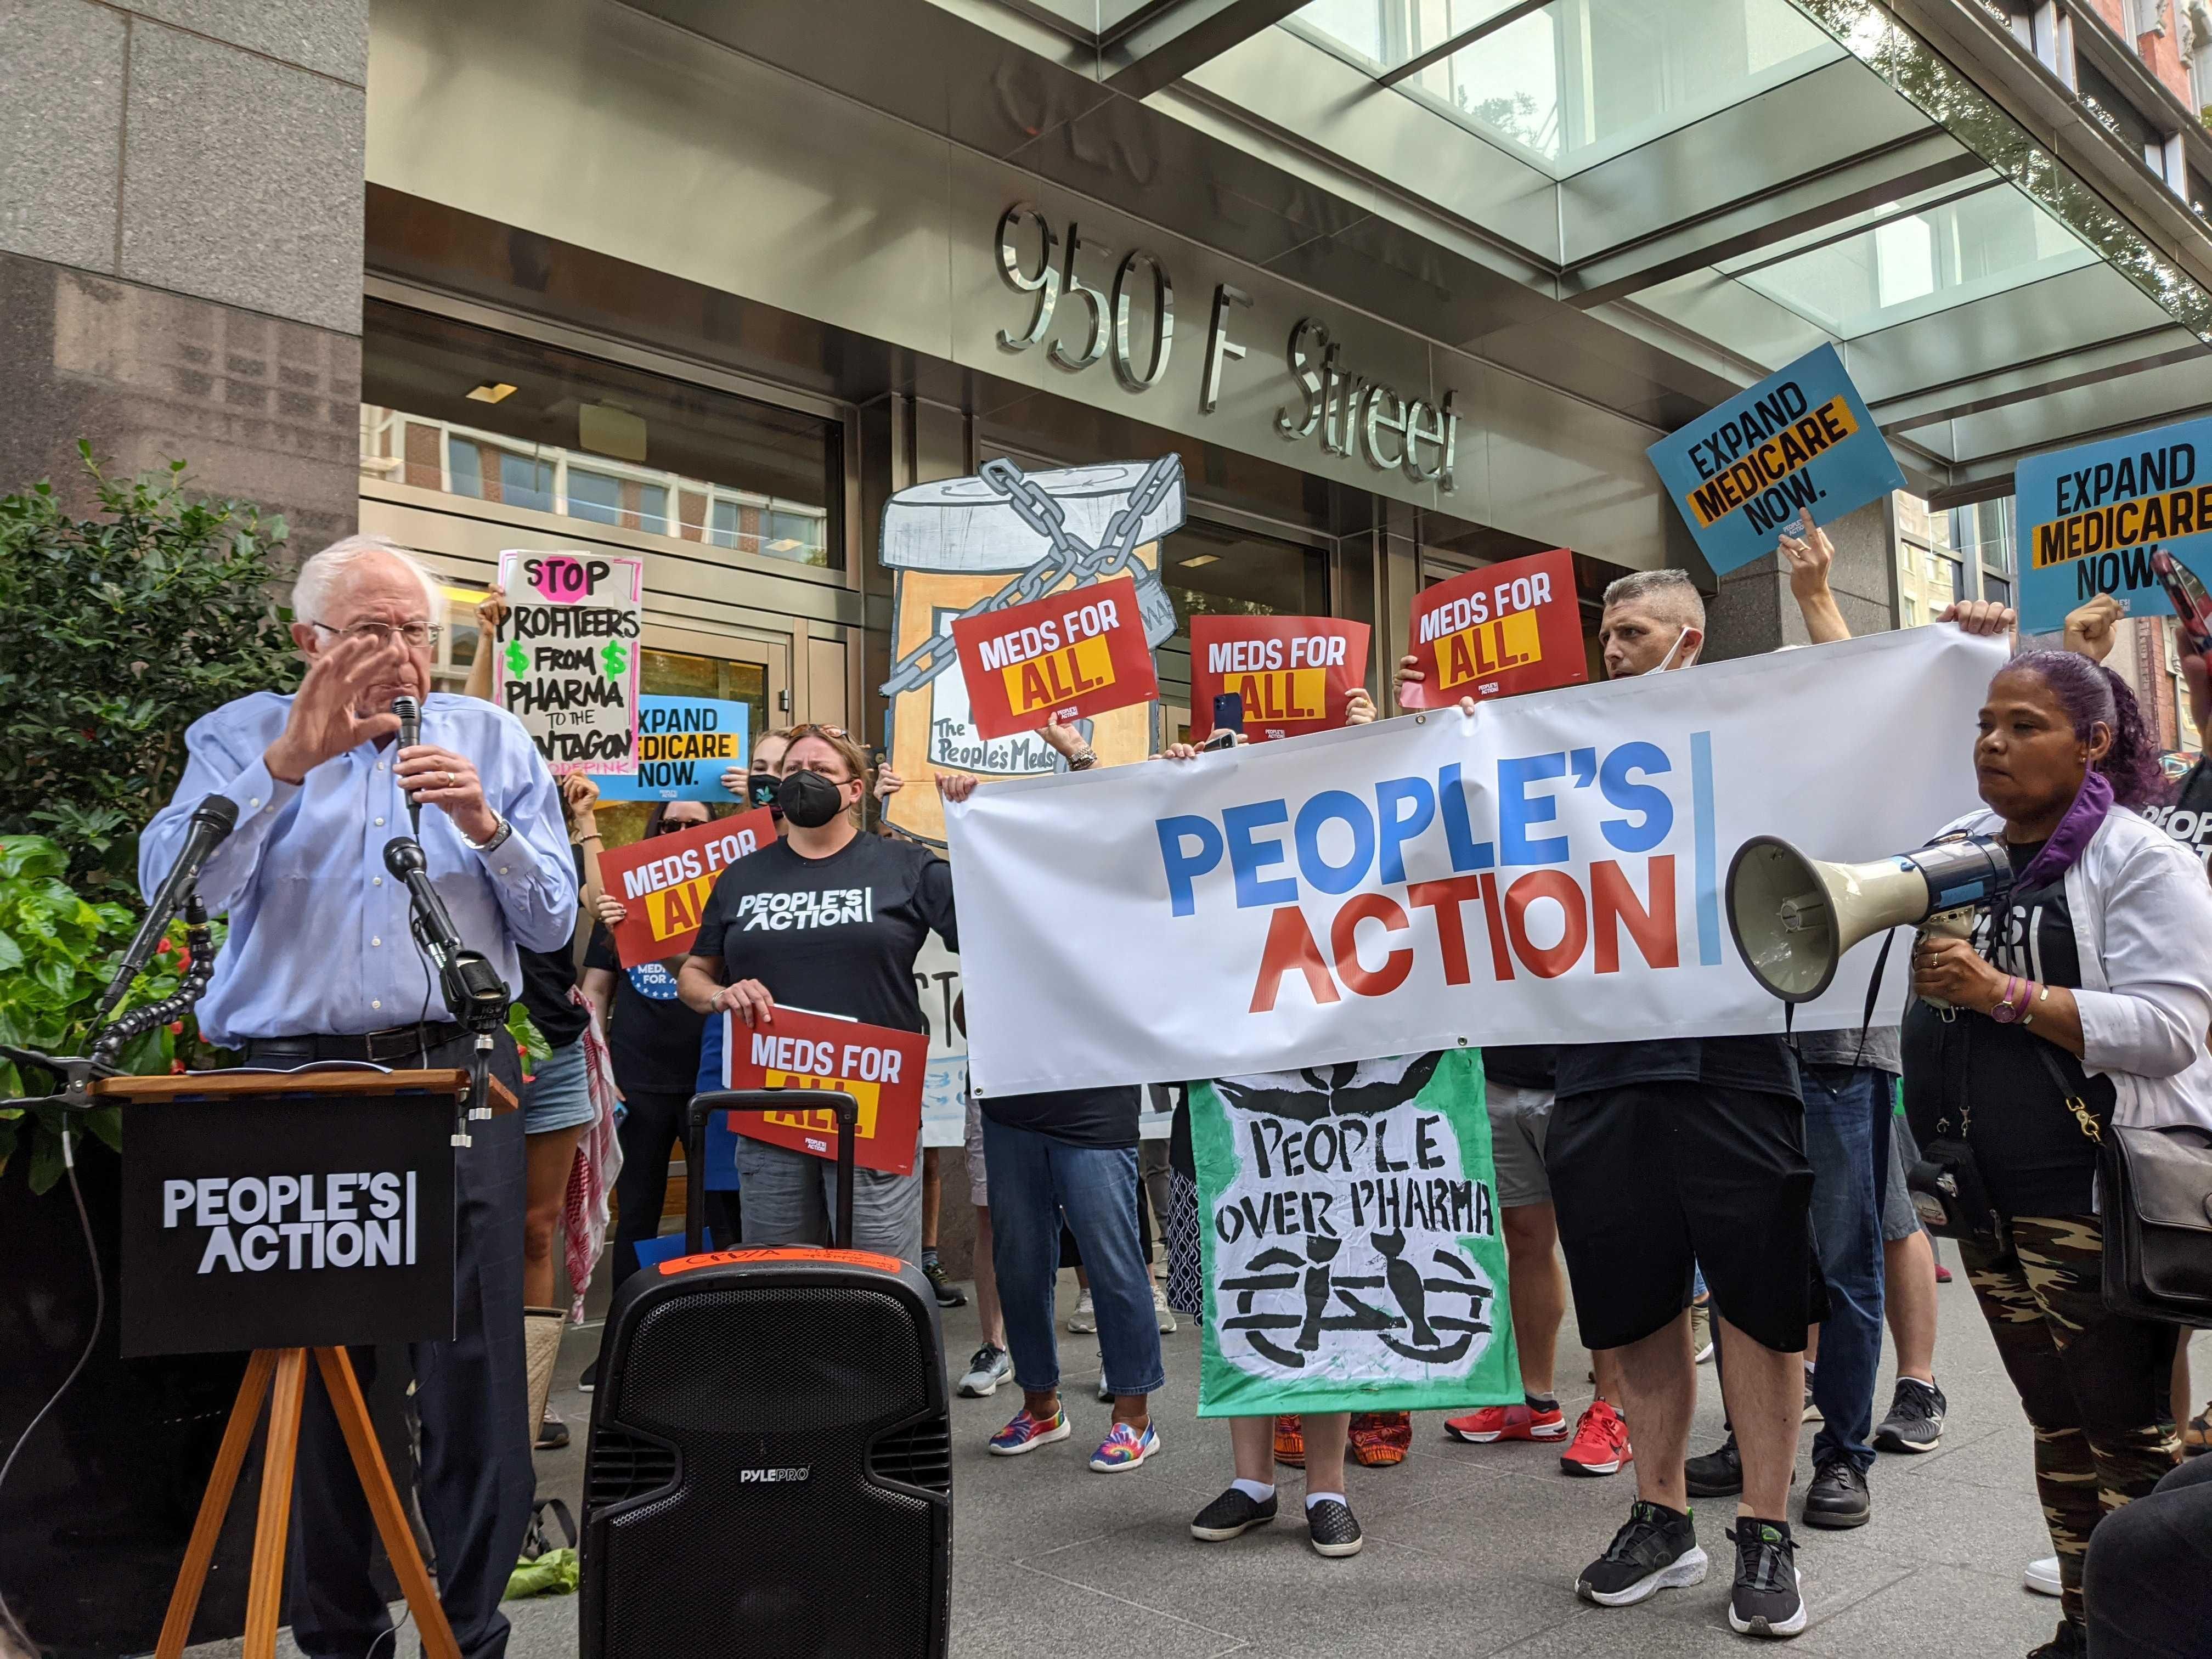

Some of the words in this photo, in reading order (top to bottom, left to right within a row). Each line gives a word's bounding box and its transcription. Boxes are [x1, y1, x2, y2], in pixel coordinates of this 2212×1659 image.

[994, 202, 1174, 393] 950
[1198, 283, 1254, 415] F
[1273, 318, 1464, 493] Street
[1688, 381, 1807, 480] EXPAND
[1693, 402, 1848, 522] MEDICARE
[2057, 443, 2194, 517] EXPAND
[1742, 467, 1826, 536] NOW.
[2040, 486, 2212, 566] MEDICARE
[524, 559, 610, 595] STOP
[979, 620, 1060, 672] MEDS
[1063, 599, 1119, 644] FOR
[1420, 592, 1488, 644] MEDS
[1494, 572, 1552, 616] FOR
[535, 647, 596, 675] FROM
[1022, 647, 1104, 710] ALL.
[1209, 637, 1282, 673] MEDS
[1290, 636, 1346, 668] FOR
[1449, 621, 1528, 685] ALL.
[505, 676, 624, 714] PHARMA
[545, 712, 566, 729] TO
[569, 710, 595, 725] THE
[638, 709, 717, 733] XPAND
[1239, 671, 1314, 723] ALL.
[532, 729, 633, 761] NTAGON
[934, 718, 965, 737] The
[938, 738, 1008, 770] People's
[1011, 738, 1055, 770] Meds
[550, 761, 629, 775] ODEPINK
[638, 761, 698, 787] NOW.
[1155, 741, 1673, 917] PEOPLE'S
[623, 849, 702, 899] MEDS
[705, 829, 757, 871] FOR
[664, 875, 716, 935] AL
[736, 889, 862, 917] PEOPLE'S
[743, 906, 862, 931] ACTION
[1248, 854, 1679, 1013] ACTION
[644, 975, 665, 984] FOR
[752, 1033, 834, 1075] MEDS
[842, 1045, 902, 1084] FOR
[1250, 1115, 1444, 1178] PEOPLE
[163, 1172, 400, 1228] PEOPLE'S
[1215, 1191, 1337, 1244] OVER
[1350, 1178, 1494, 1235] PHARMA
[197, 1219, 400, 1274] ACTION
[741, 1468, 809, 1483] PYLEPRO
